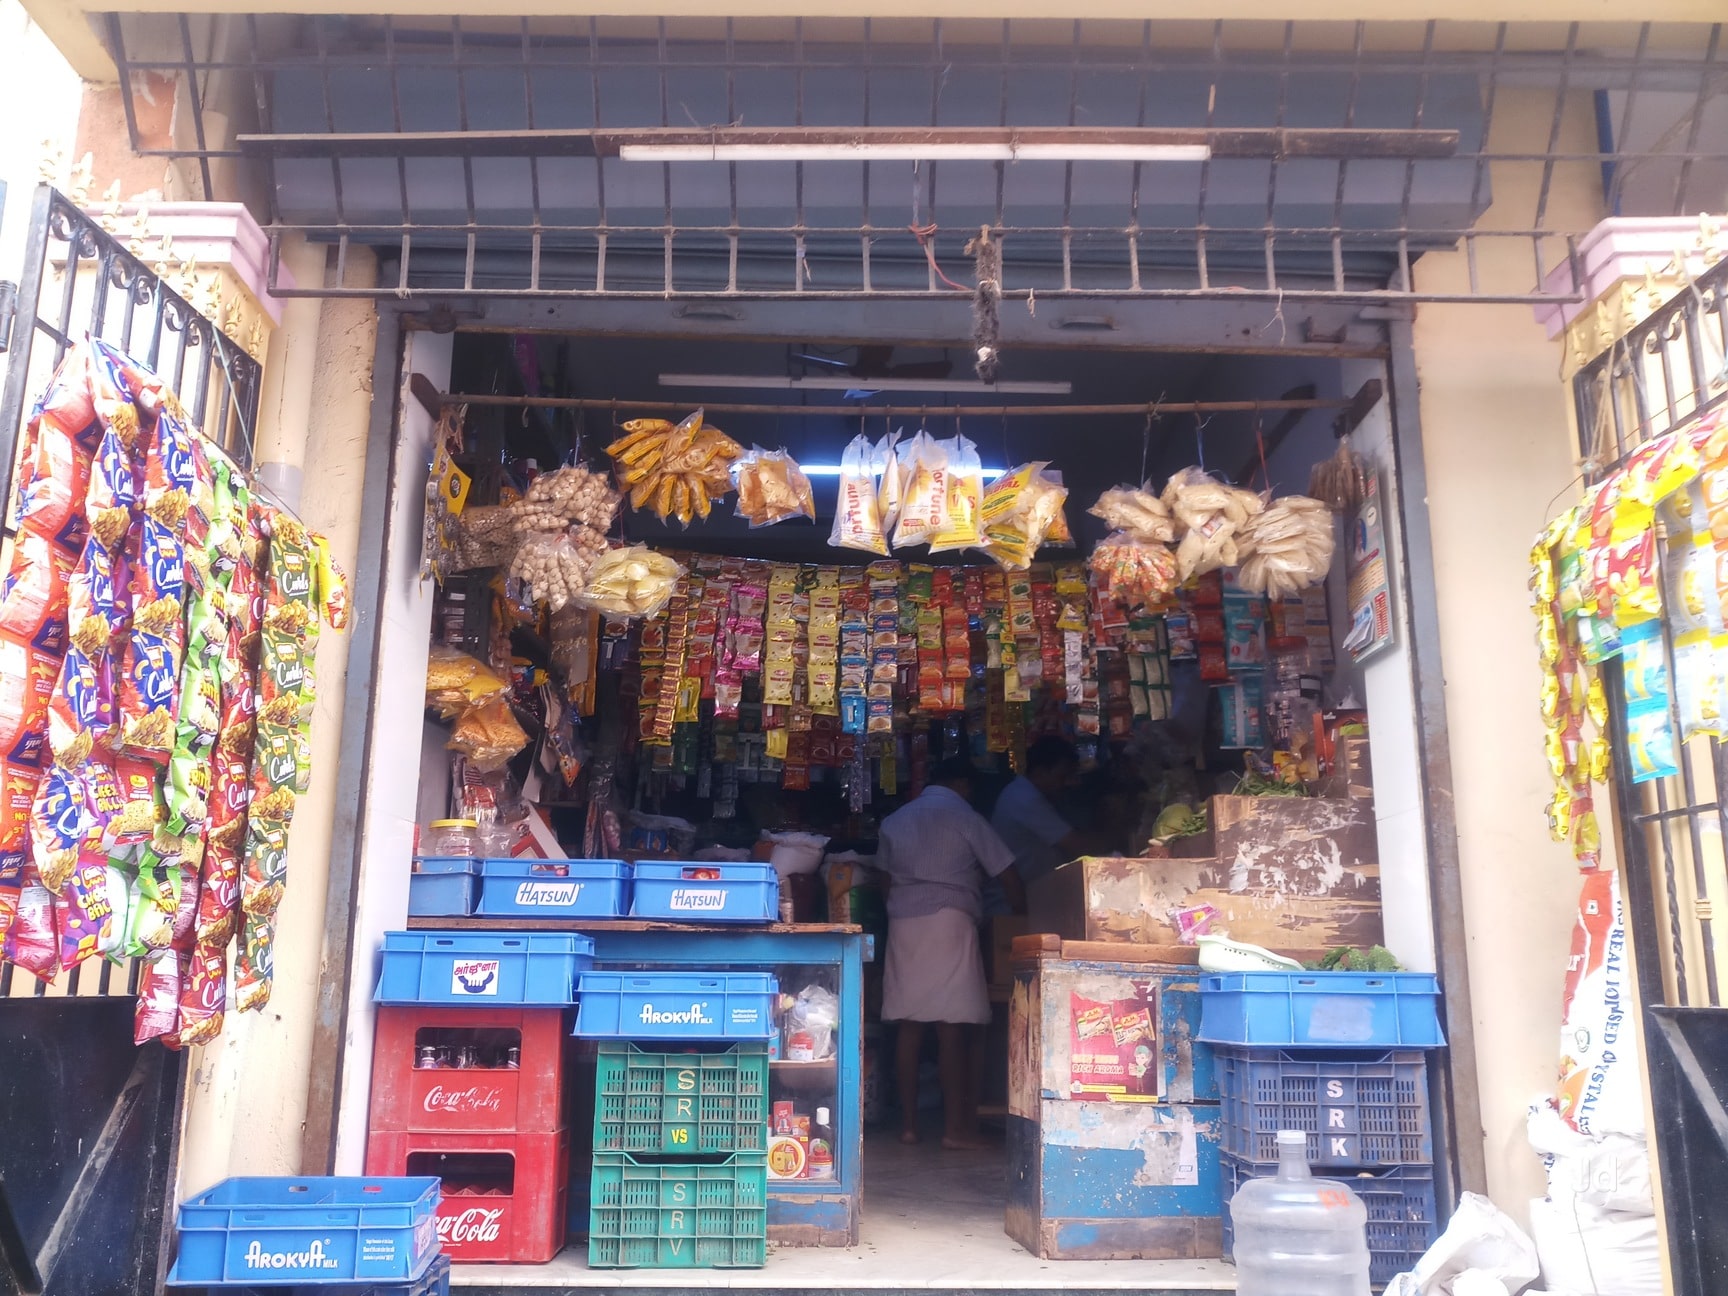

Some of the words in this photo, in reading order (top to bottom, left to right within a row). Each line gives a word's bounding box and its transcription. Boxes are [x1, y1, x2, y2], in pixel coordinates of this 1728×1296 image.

[519, 882, 577, 904] HATSUN
[674, 889, 724, 908] HATSUN
[640, 1003, 703, 1024] AROKYA
[1094, 1064, 1124, 1075] AROMA
[672, 1128, 688, 1144] VS
[434, 1208, 505, 1242] ca-Cola
[244, 1240, 326, 1269] AROKYA
